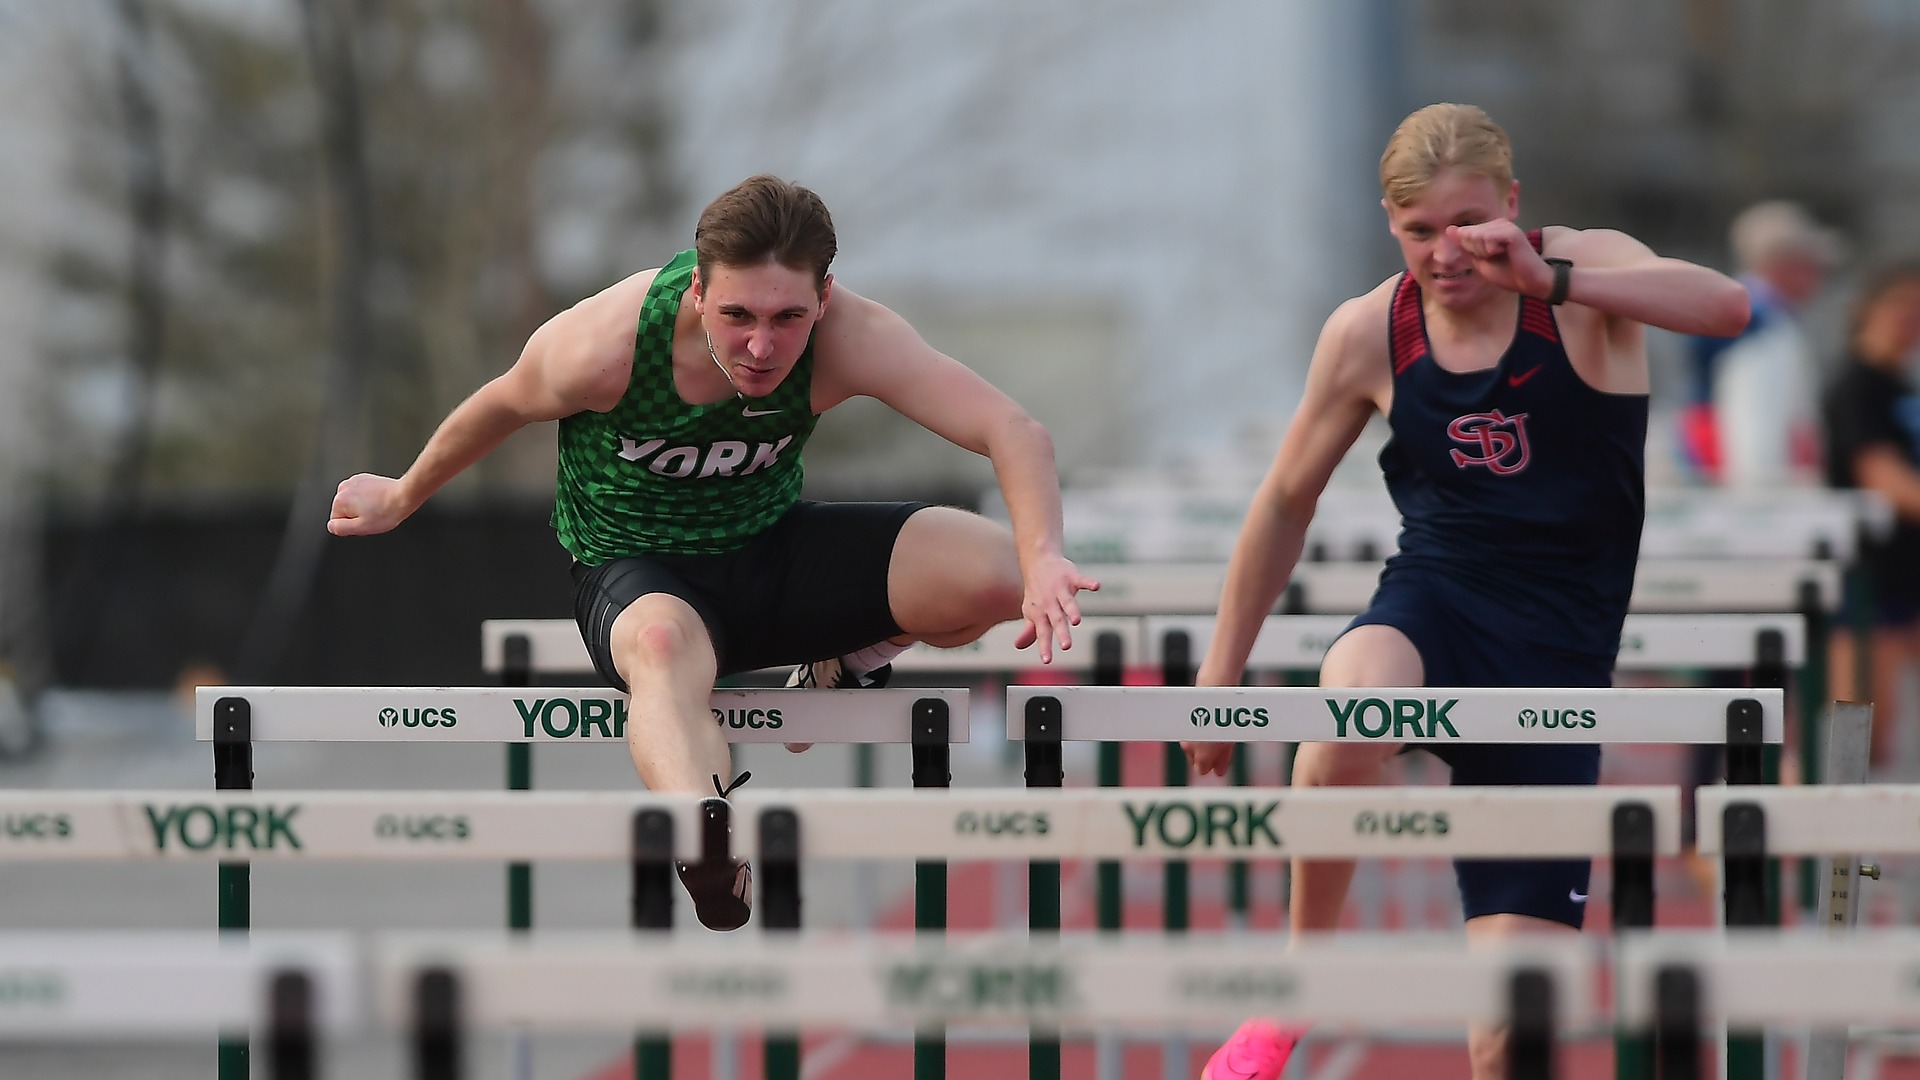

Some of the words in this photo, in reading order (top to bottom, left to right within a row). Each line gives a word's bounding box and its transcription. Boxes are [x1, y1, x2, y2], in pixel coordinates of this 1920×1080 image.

[617, 434, 793, 479] YORK
[1447, 409, 1530, 475] SU
[402, 707, 458, 728] UCS
[728, 708, 784, 729] UCS
[1214, 707, 1270, 728] UCS
[1325, 697, 1461, 738] YORK
[1541, 708, 1597, 729] UCS
[6, 812, 72, 839] UCS
[144, 803, 304, 851] YORK
[401, 813, 471, 840] UCS
[985, 811, 1051, 836] UCS
[1122, 801, 1282, 849] YORK
[1382, 810, 1451, 837] UCS
